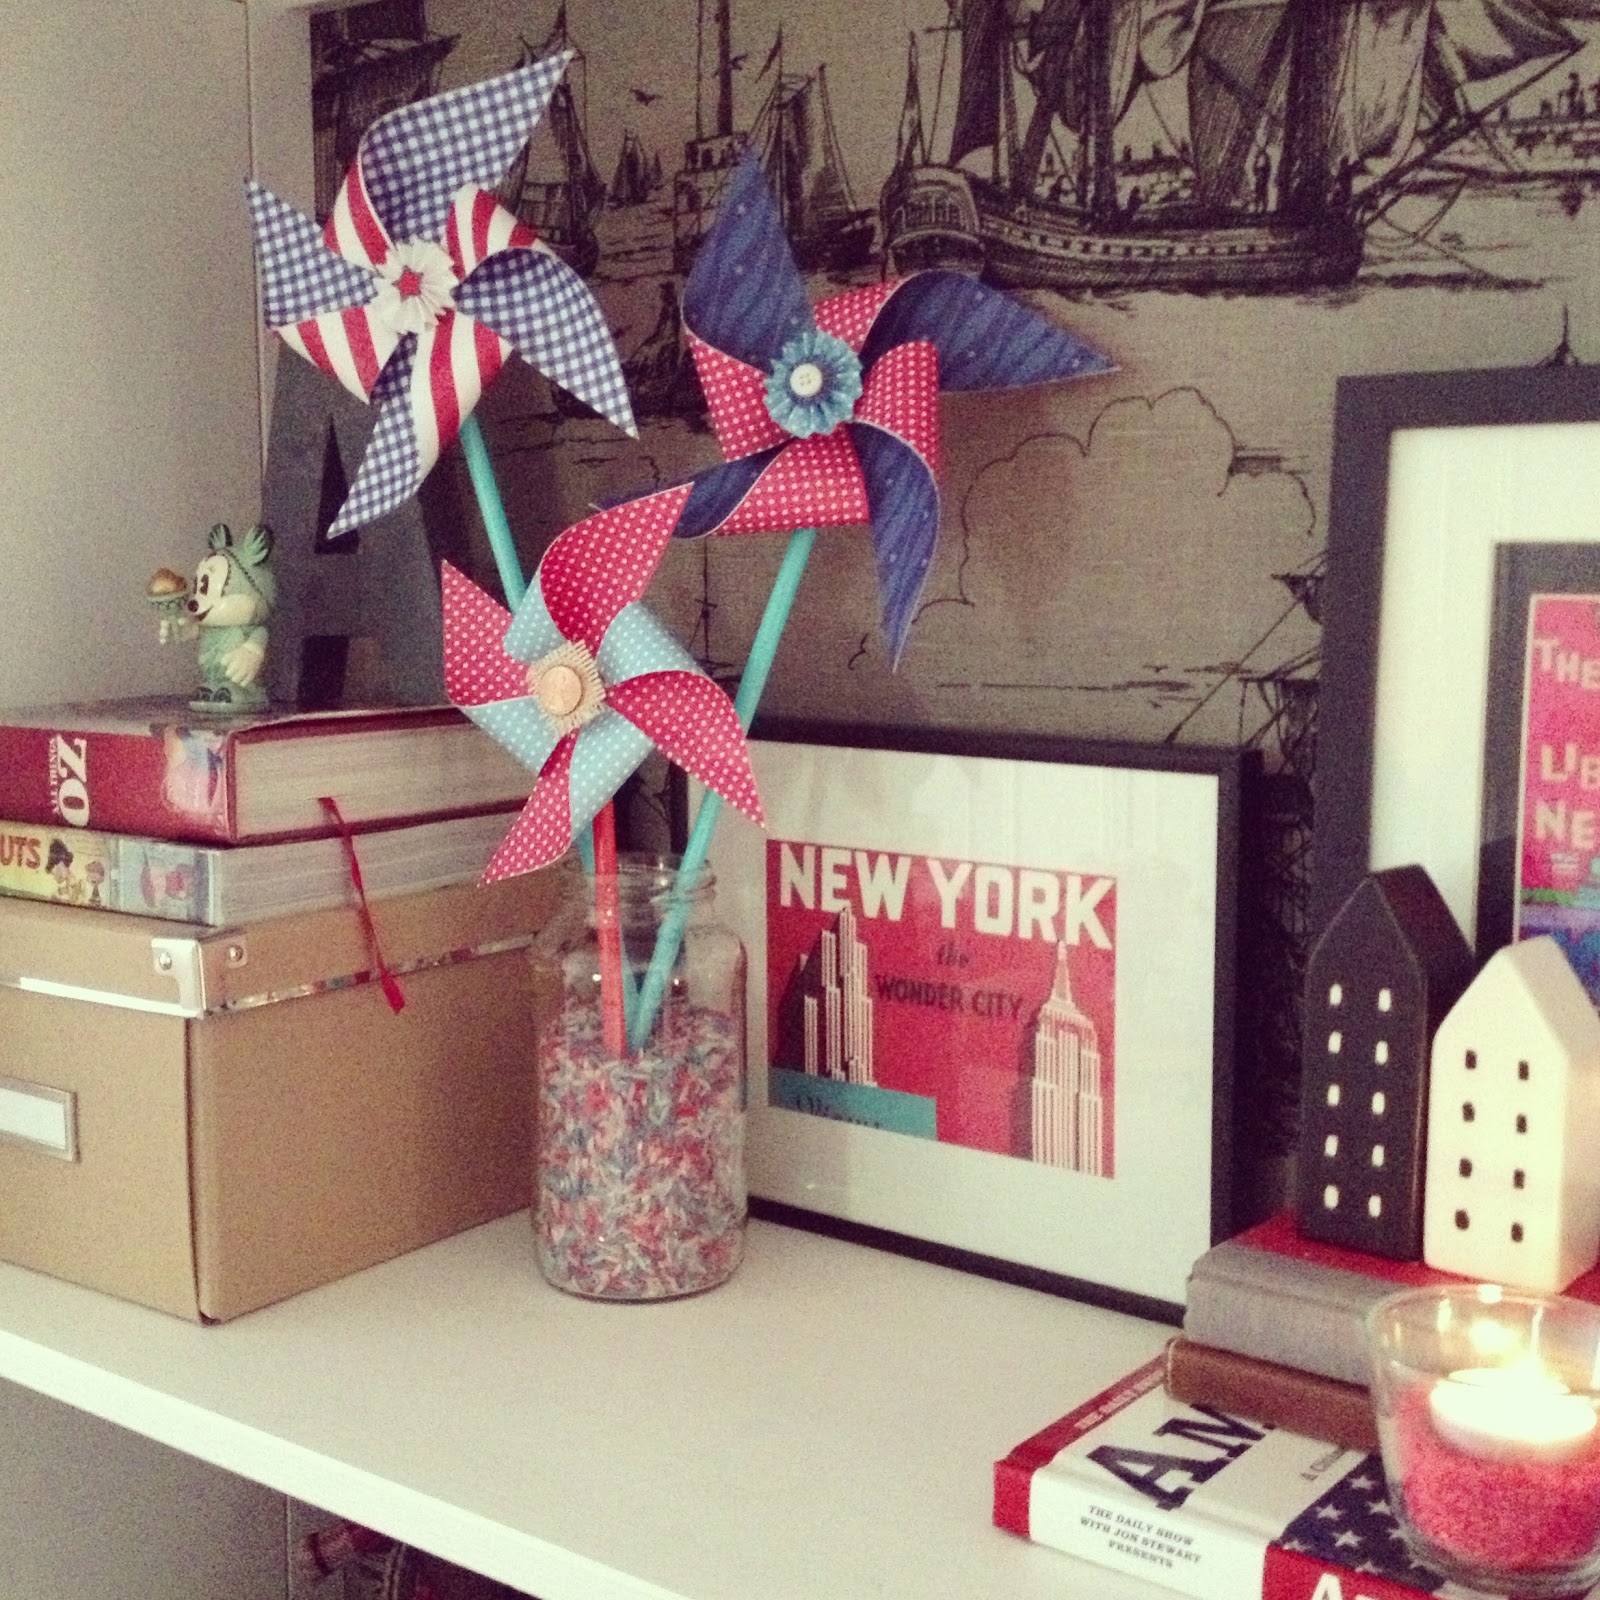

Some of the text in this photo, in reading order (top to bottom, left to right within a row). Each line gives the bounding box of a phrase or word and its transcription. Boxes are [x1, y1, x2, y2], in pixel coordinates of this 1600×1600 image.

[49, 737, 58, 786] THINGS
[57, 734, 90, 828] OZ
[780, 843, 1115, 950] NEW YORK
[936, 942, 970, 969] the
[875, 974, 1023, 1020] WONDER CITY
[1080, 1516, 1201, 1563] WITH JON STEWART
[1089, 1505, 1193, 1546] THE DAILY SHOW
[1108, 1539, 1173, 1568] PRESENTS
